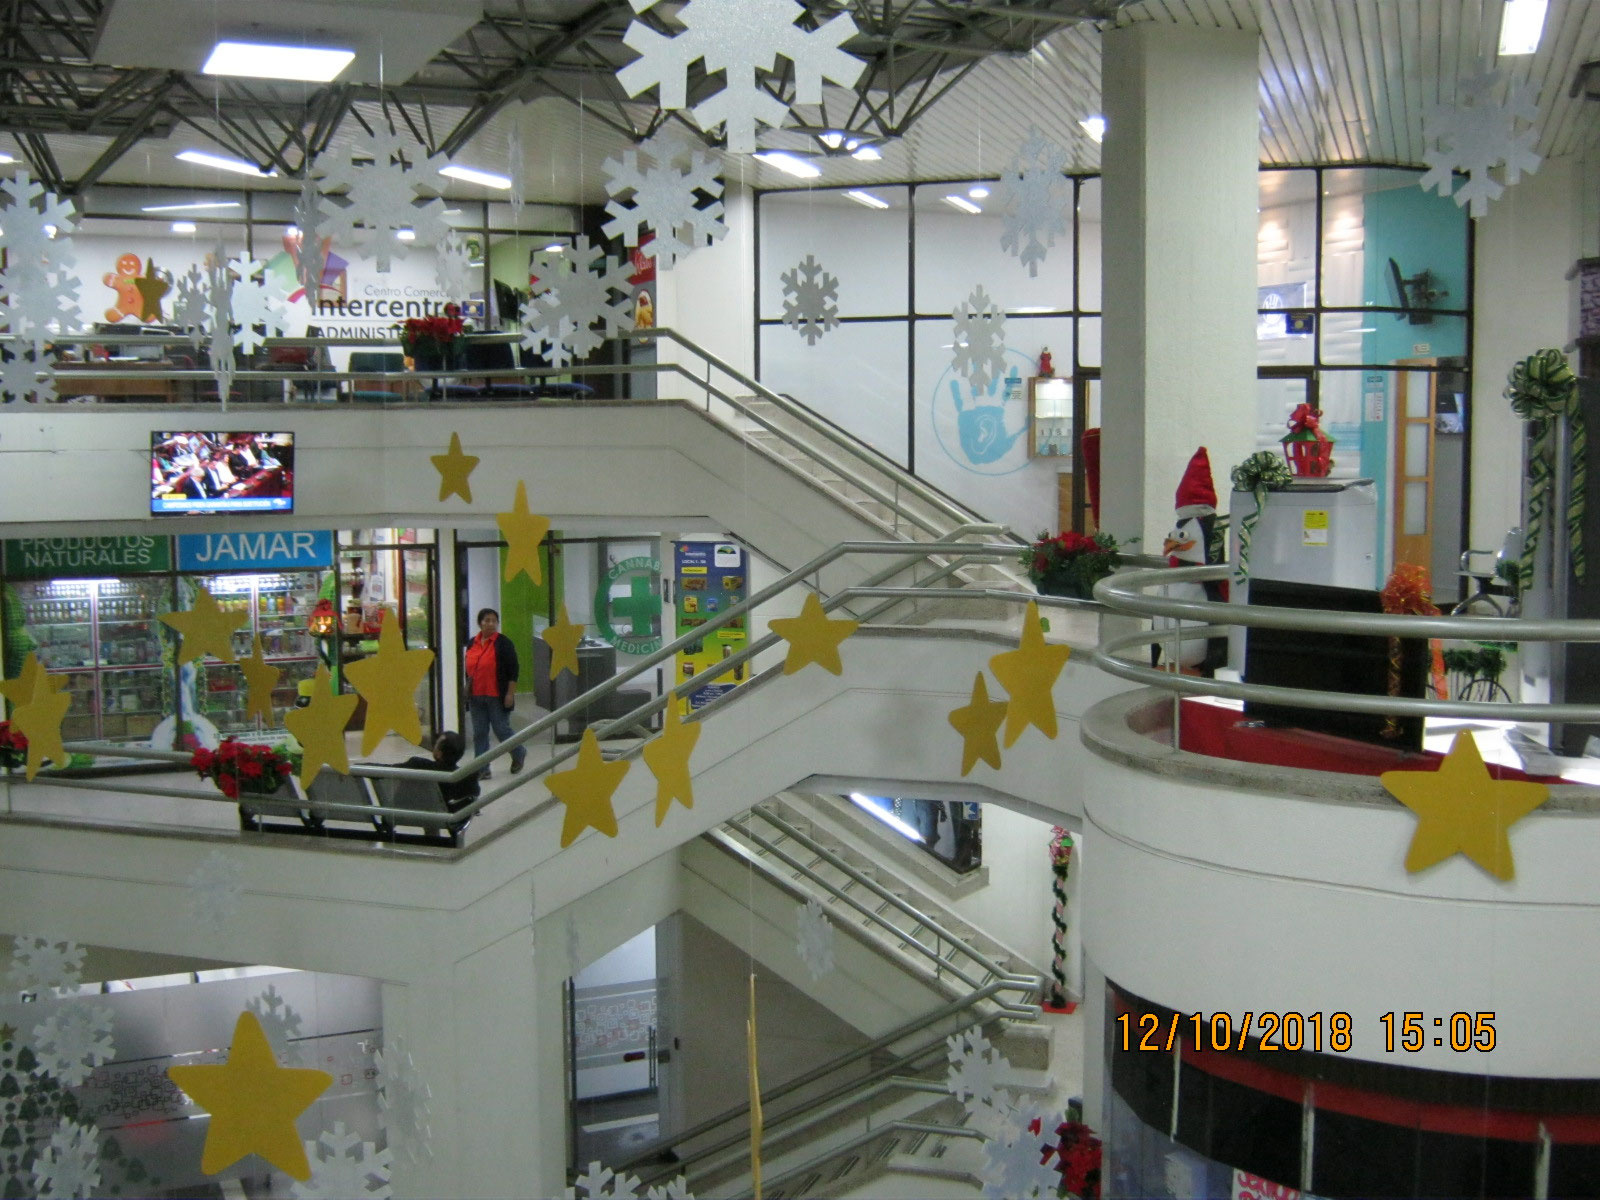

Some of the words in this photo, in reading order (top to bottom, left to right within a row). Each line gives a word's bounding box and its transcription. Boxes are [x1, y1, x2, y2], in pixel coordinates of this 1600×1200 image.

[364, 285, 401, 297] Centro
[20, 536, 155, 550] PRODUCTOS
[195, 532, 317, 562] JAMAR
[25, 548, 151, 567] NATURALES
